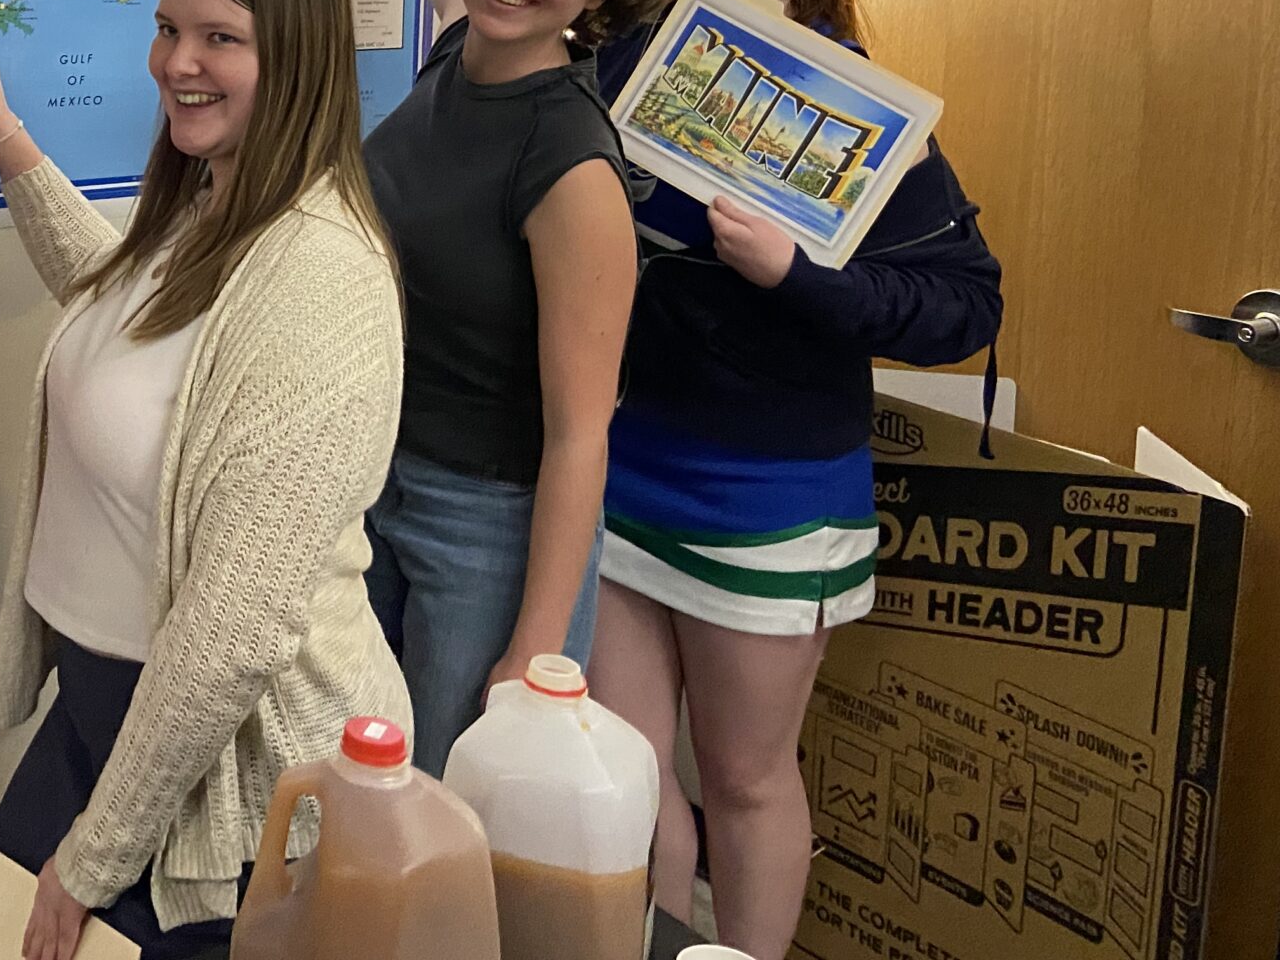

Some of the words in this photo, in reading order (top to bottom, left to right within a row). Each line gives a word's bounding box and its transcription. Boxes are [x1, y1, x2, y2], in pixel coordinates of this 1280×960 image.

[59, 53, 93, 65] GULF
[67, 75, 86, 86] OF
[47, 95, 103, 108] MEXICO
[663, 24, 876, 202] MAINE
[872, 408, 925, 448] kills
[873, 477, 911, 503] ect
[1135, 505, 1179, 518] INCHES
[876, 511, 1029, 569] OARD
[1050, 525, 1156, 583] KIT
[927, 589, 1104, 645] HEADER
[915, 690, 952, 721] BAKE
[953, 703, 988, 737] SALE
[1016, 703, 1072, 743] SPLASH
[1181, 786, 1202, 866] HEADER
[805, 898, 843, 934] FOR
[847, 921, 883, 955] THE
[817, 880, 852, 913] THE
[858, 903, 961, 960] COMPLET
[1172, 901, 1189, 942] KIT
